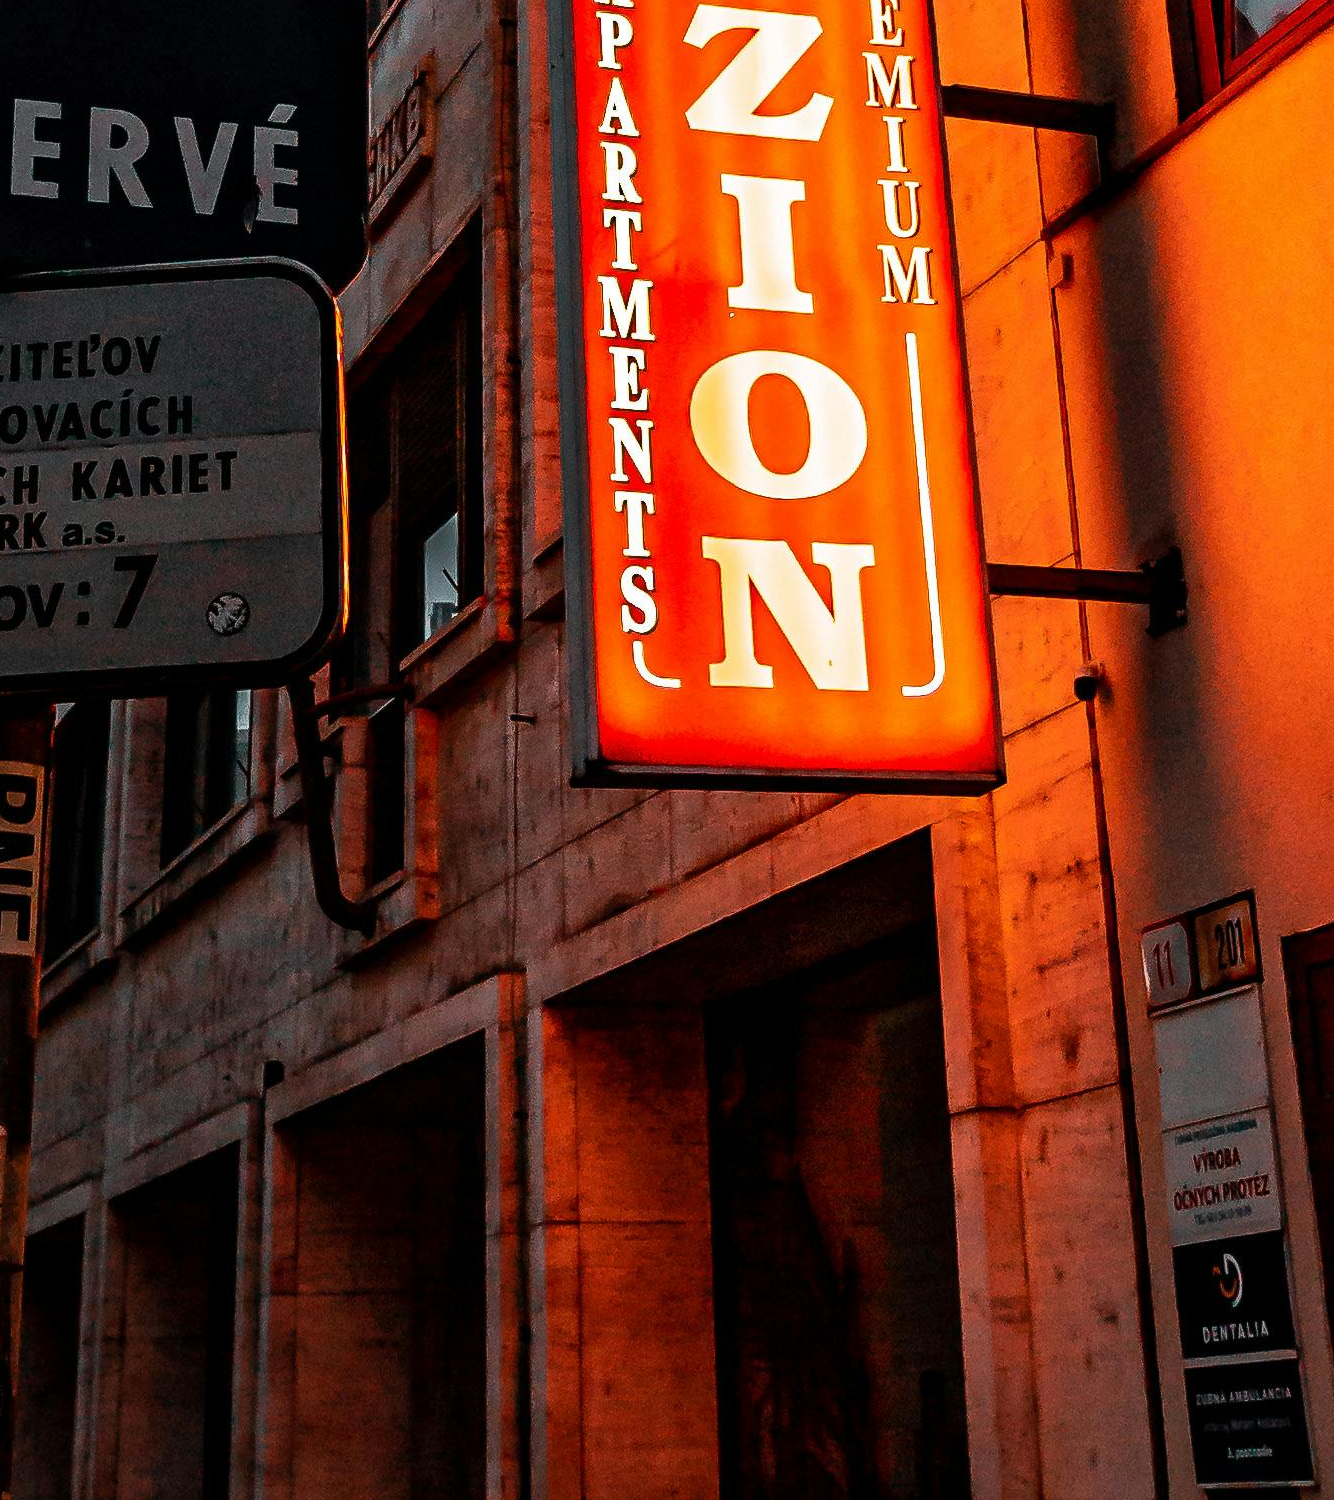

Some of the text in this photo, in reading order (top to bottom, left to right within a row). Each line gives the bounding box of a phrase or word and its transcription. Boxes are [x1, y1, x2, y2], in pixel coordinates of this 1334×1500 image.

[72, 451, 237, 501] KARIET
[63, 521, 126, 547] a.s.
[113, 554, 159, 629] 7
[1202, 1320, 1269, 1344] DENTALIA
